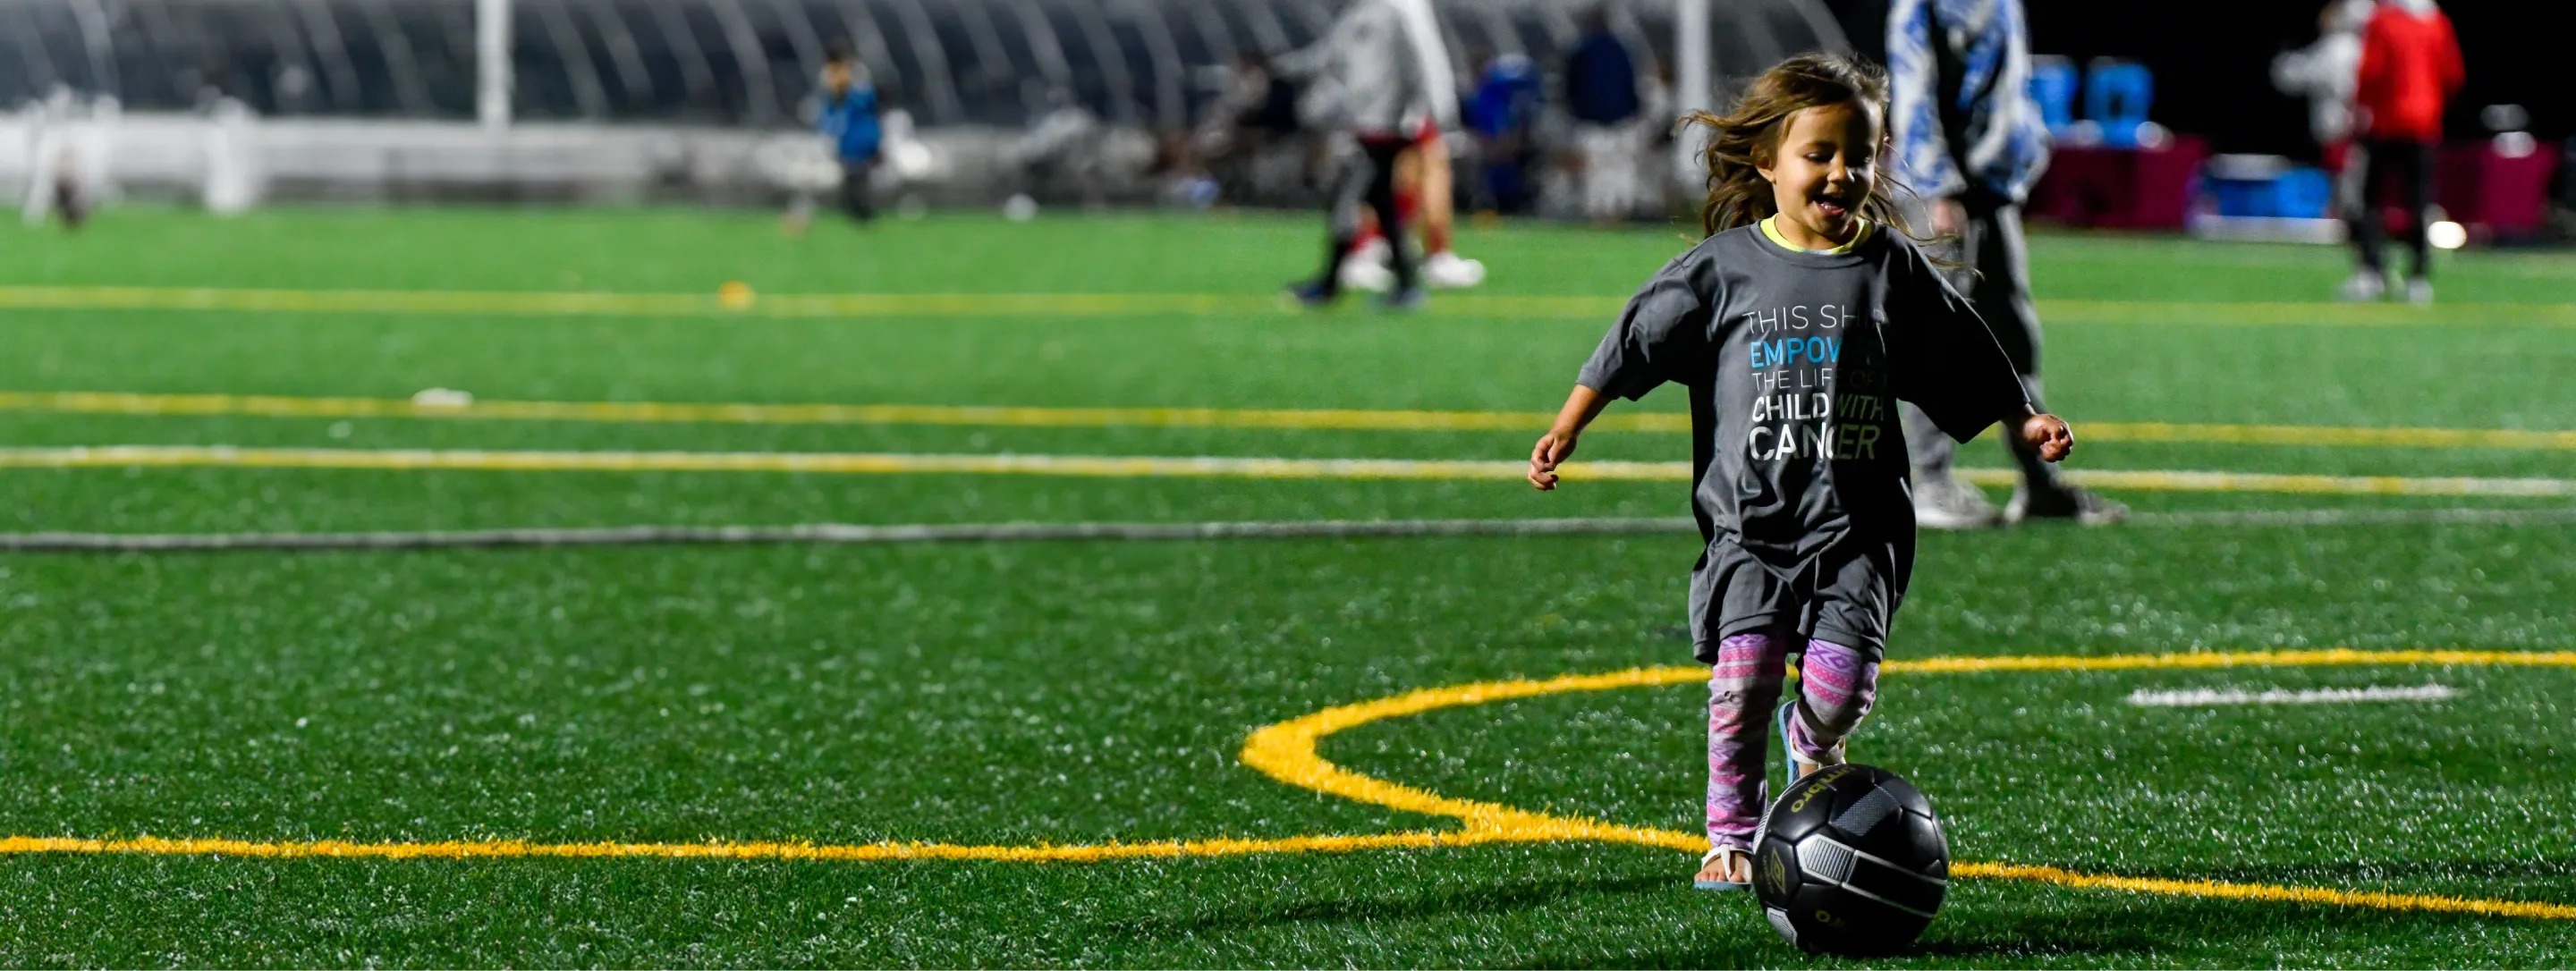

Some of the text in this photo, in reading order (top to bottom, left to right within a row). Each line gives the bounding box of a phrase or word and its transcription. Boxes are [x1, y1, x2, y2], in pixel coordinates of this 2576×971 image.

[1742, 306, 1809, 334] THIS
[1752, 370, 1791, 391] THE
[1800, 367, 1842, 387] LIF
[1751, 393, 1830, 423] CHILD
[1749, 422, 1881, 461] CANCER
